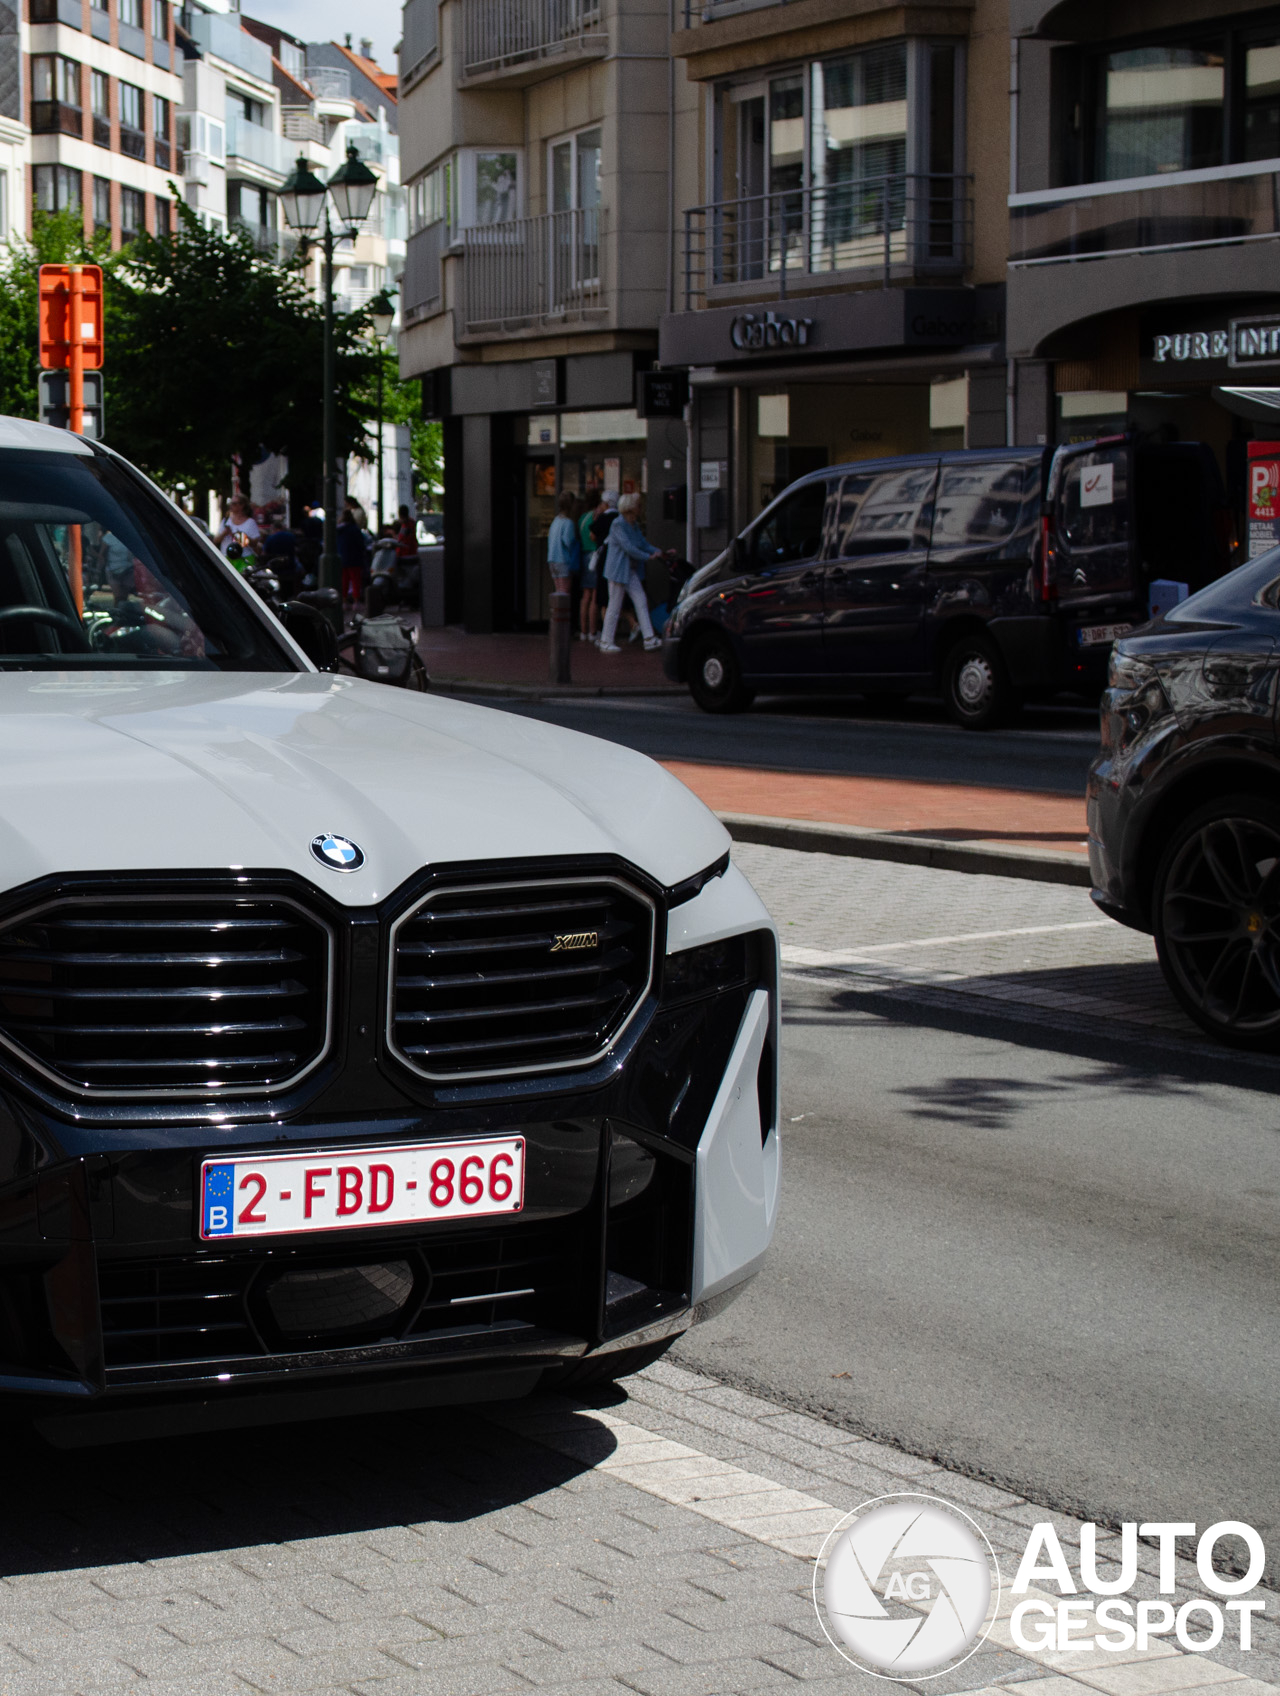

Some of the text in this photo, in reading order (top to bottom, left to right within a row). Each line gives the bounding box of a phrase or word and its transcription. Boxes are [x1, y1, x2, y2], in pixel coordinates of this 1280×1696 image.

[730, 311, 814, 350] Gabor
[1152, 330, 1229, 362] PURE
[1254, 507, 1276, 516] 4411
[1249, 522, 1275, 531] BETAAL
[1249, 531, 1275, 539] MOBIEL
[238, 1152, 515, 1224] 2-FBD-866
[208, 1205, 229, 1230] B
